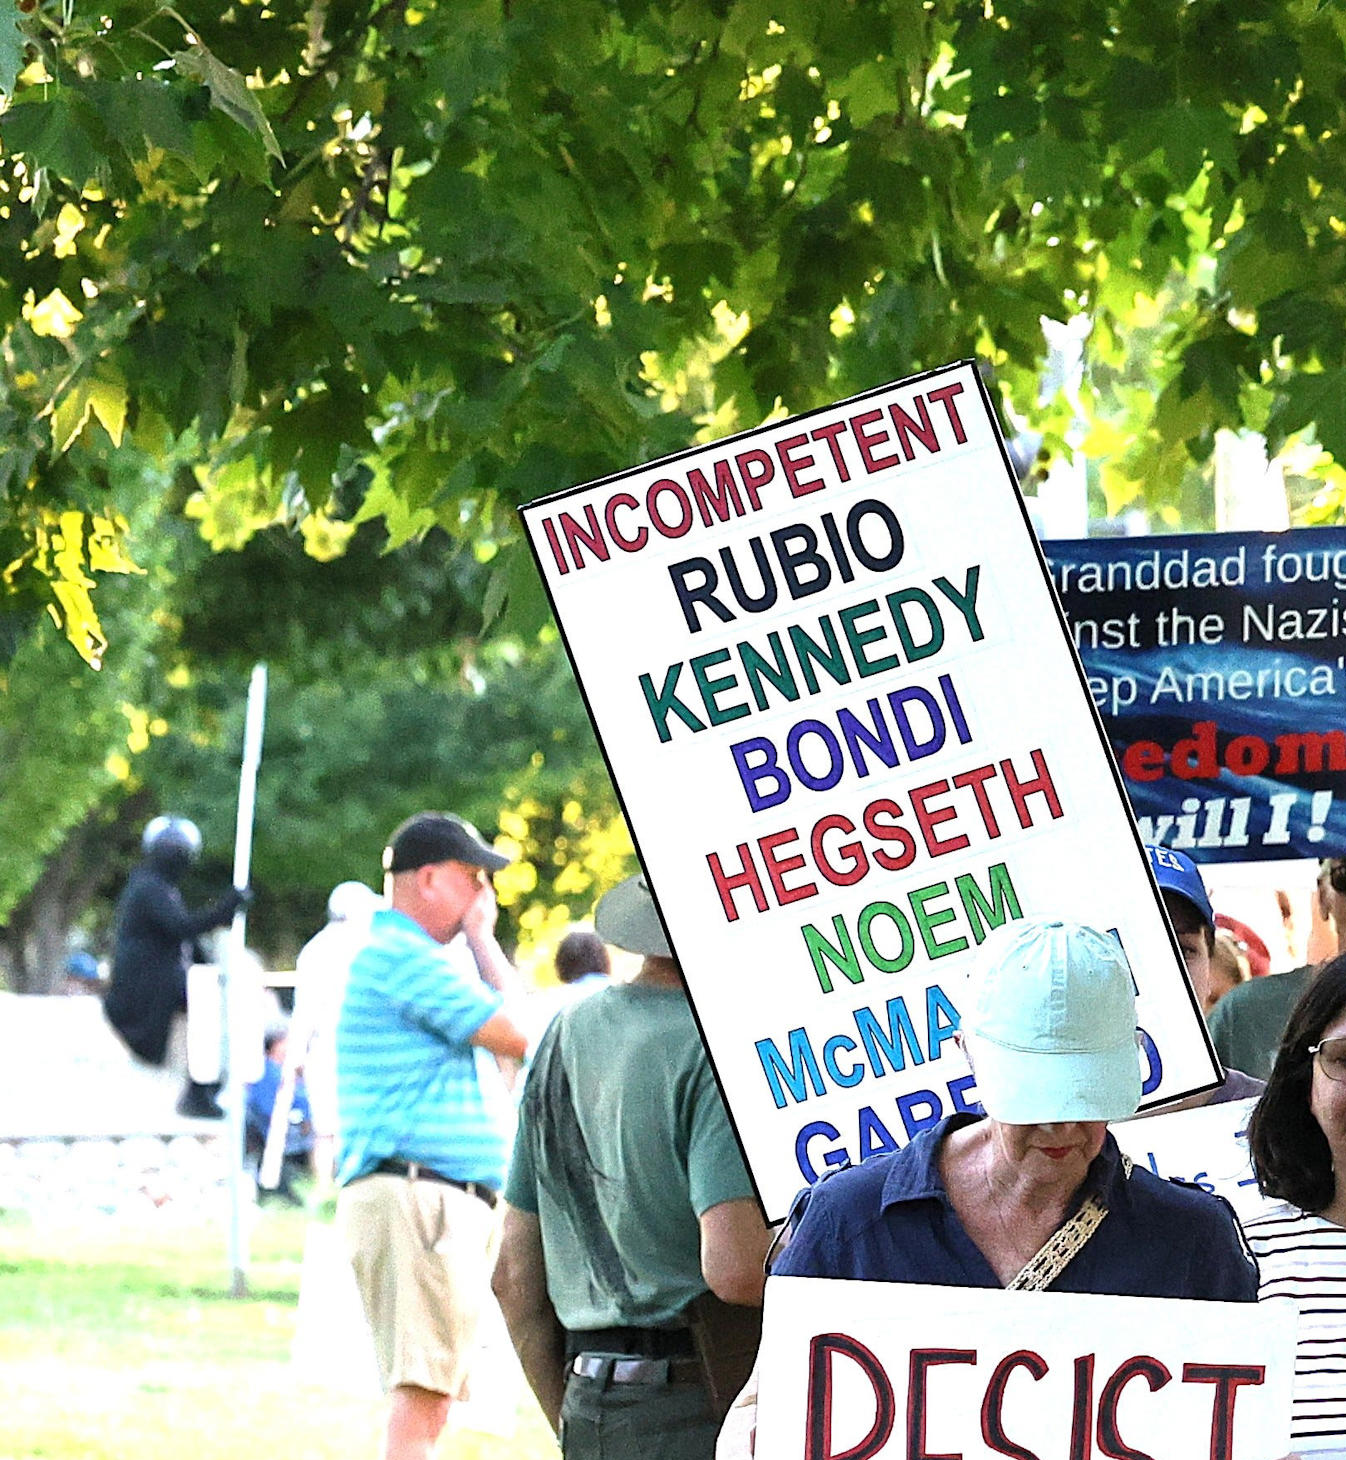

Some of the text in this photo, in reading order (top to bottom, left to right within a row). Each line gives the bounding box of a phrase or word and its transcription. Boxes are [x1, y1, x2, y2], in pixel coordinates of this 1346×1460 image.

[542, 382, 970, 576] INCOMPETENT
[667, 498, 906, 634] RUBIO
[1155, 606, 1225, 647] the
[638, 565, 988, 744] KENNEDY
[731, 675, 974, 813] BONDI
[705, 749, 1065, 923] HEGSETH
[800, 862, 1025, 994] NOEM
